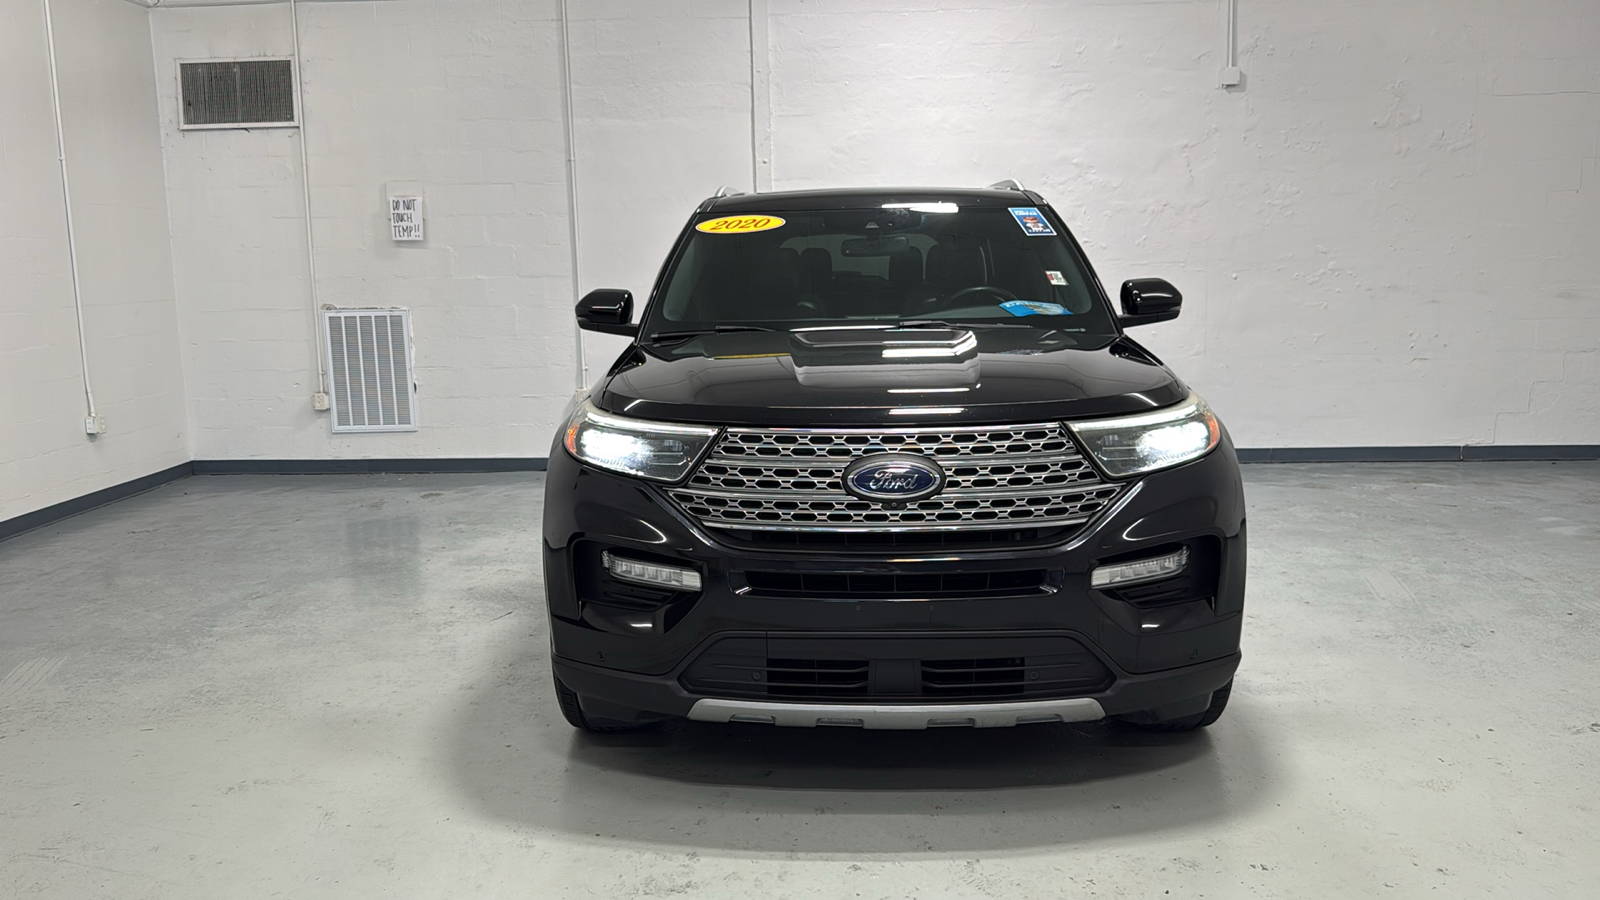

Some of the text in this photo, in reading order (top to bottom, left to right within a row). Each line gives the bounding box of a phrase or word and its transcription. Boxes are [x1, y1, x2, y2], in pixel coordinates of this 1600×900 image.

[392, 198, 417, 211] DO NOT
[392, 212, 412, 224] TOUCH
[709, 218, 770, 230] 2020
[393, 224, 420, 238] TEMP!!
[869, 468, 918, 490] Ford
